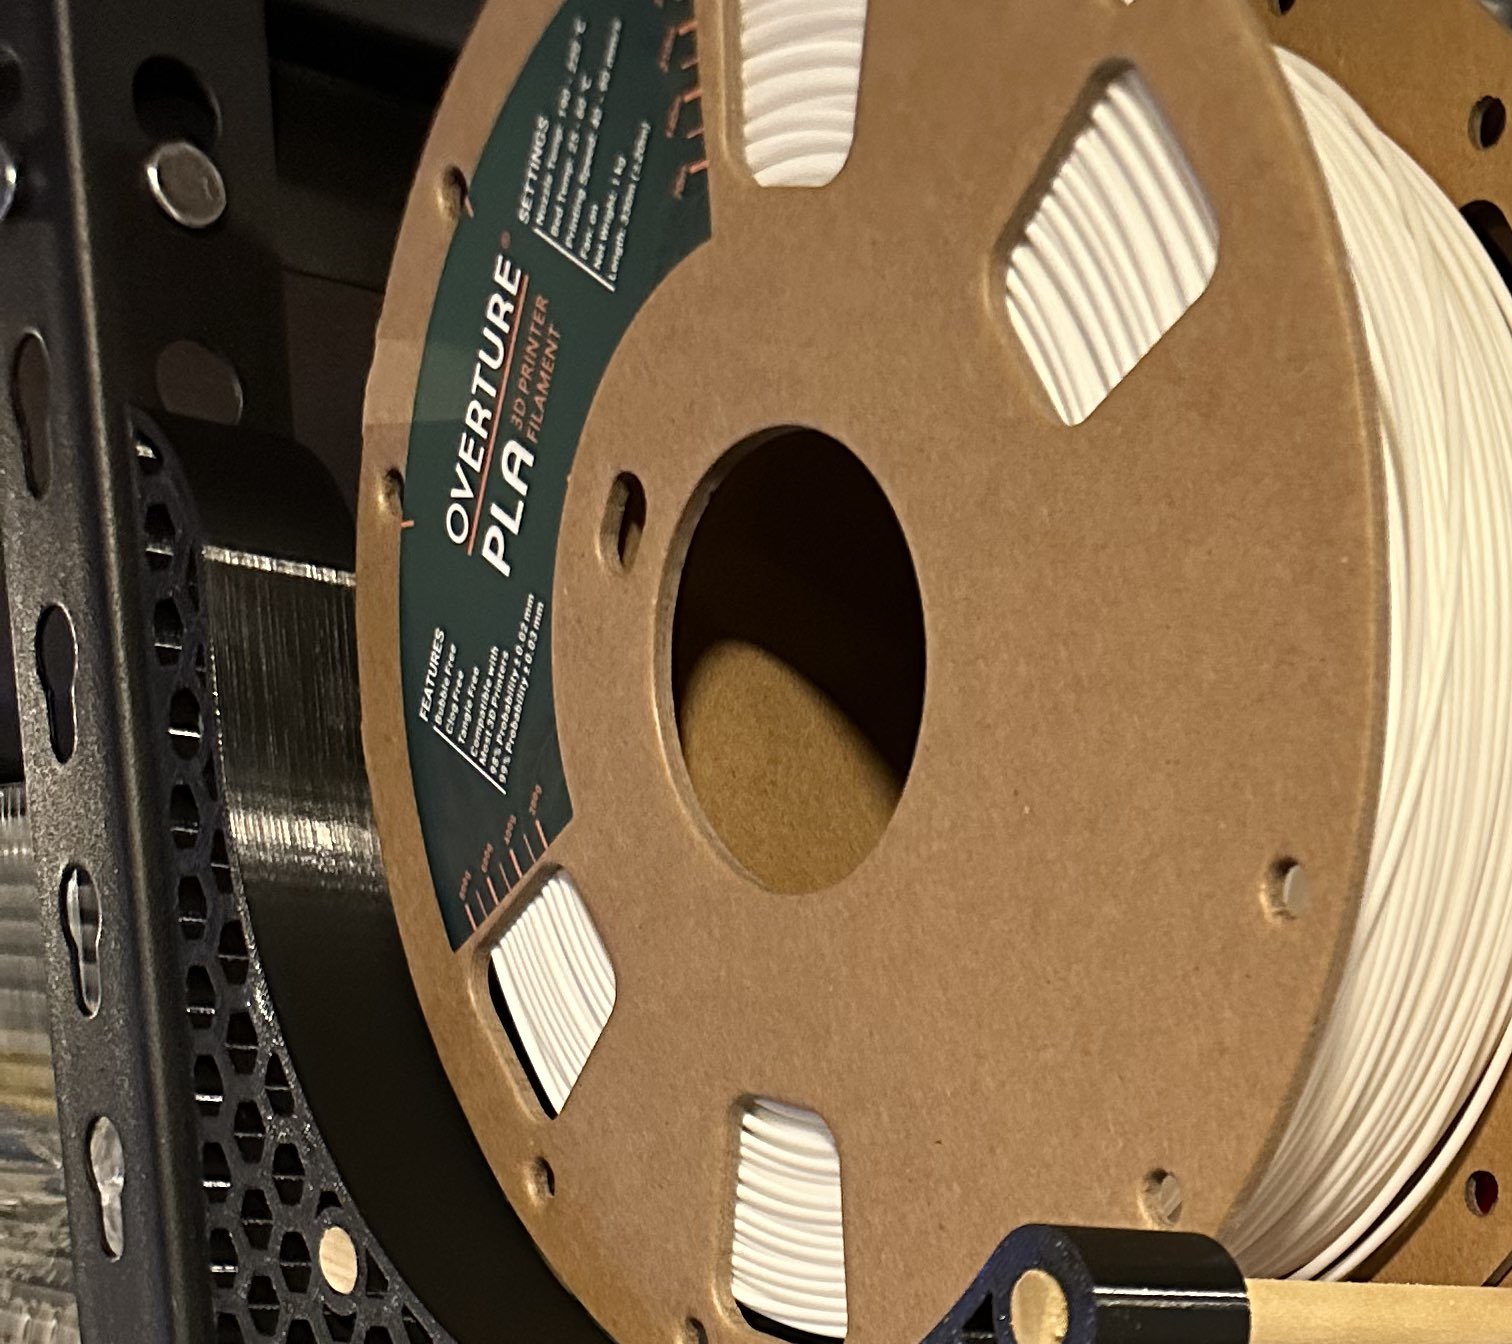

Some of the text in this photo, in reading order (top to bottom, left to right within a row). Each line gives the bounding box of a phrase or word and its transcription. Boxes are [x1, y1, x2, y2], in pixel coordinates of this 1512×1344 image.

[518, 115, 549, 225] SETTINGS
[535, 173, 553, 226] Nozzle
[550, 205, 564, 238] Bed
[564, 187, 587, 250] Printing
[589, 203, 599, 225] on
[592, 243, 606, 270] Net
[613, 155, 627, 176] kg
[445, 255, 522, 544] OVERTURE
[511, 295, 549, 431] 3D PRINTER
[526, 323, 561, 444] FILAMENT
[481, 439, 535, 578] PLA
[418, 627, 445, 723] FEATURES
[434, 643, 457, 726] Bubble Free
[445, 669, 465, 735] Clog Free
[457, 666, 480, 744] Tangle Free
[470, 645, 499, 758] Compatible with
[478, 650, 509, 766] Most 3D Printers
[495, 668, 519, 746] Probability
[523, 593, 535, 623] mm
[498, 756, 511, 783] 99%
[505, 676, 529, 755] Probability
[533, 601, 544, 630] mm
